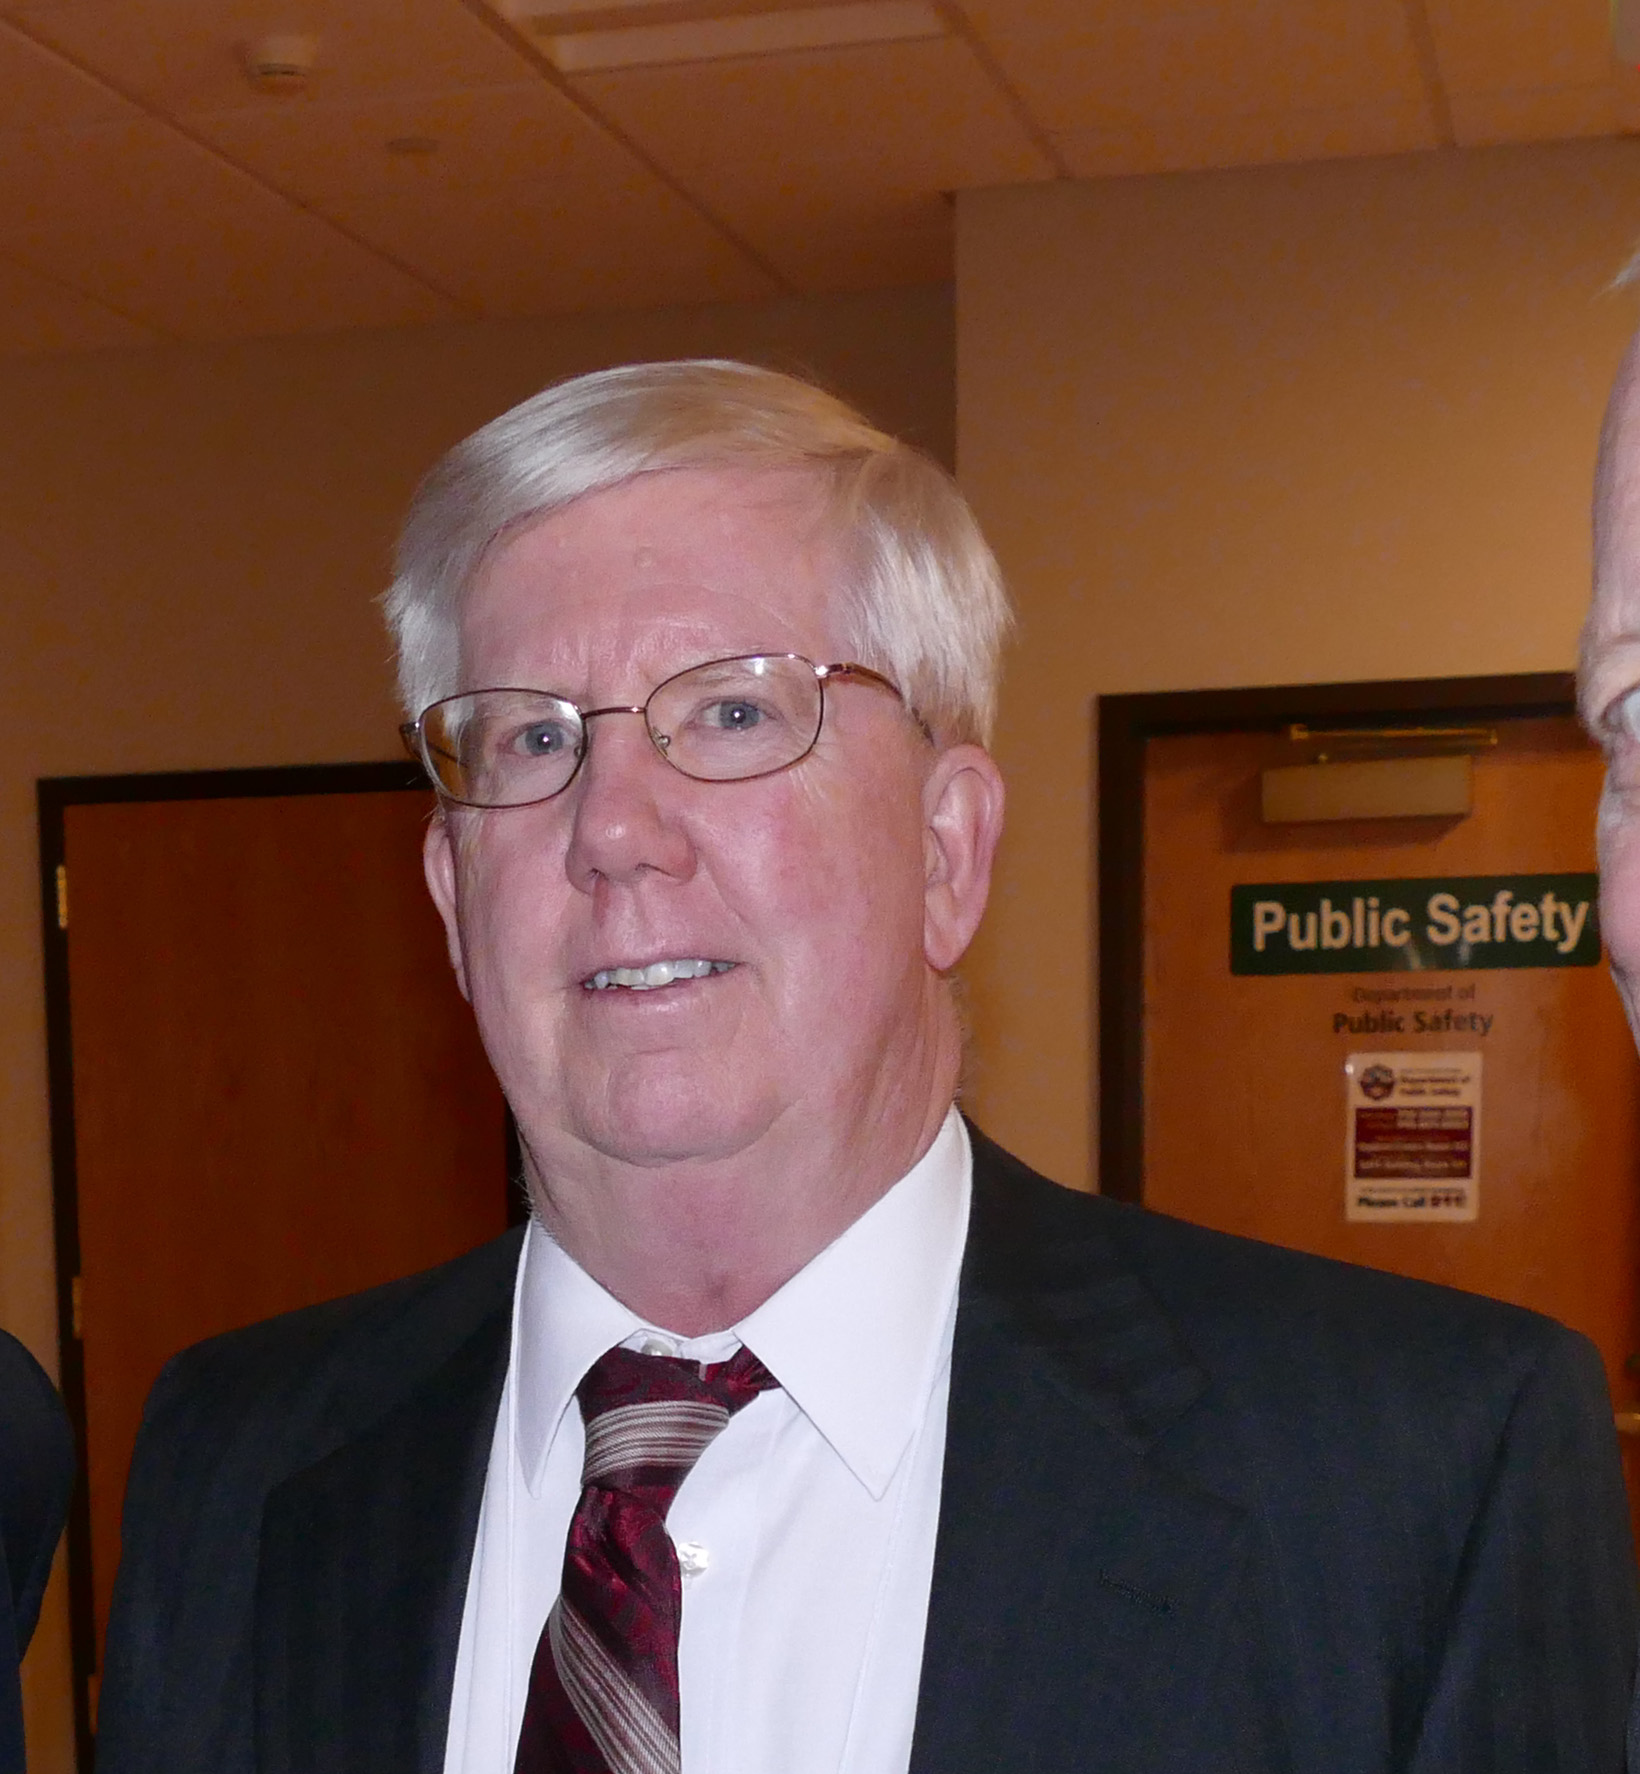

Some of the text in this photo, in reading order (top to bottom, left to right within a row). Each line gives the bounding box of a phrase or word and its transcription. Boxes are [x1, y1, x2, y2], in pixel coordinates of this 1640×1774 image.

[1253, 889, 1590, 954] Public Safety
[1332, 1008, 1494, 1037] Public Safety
